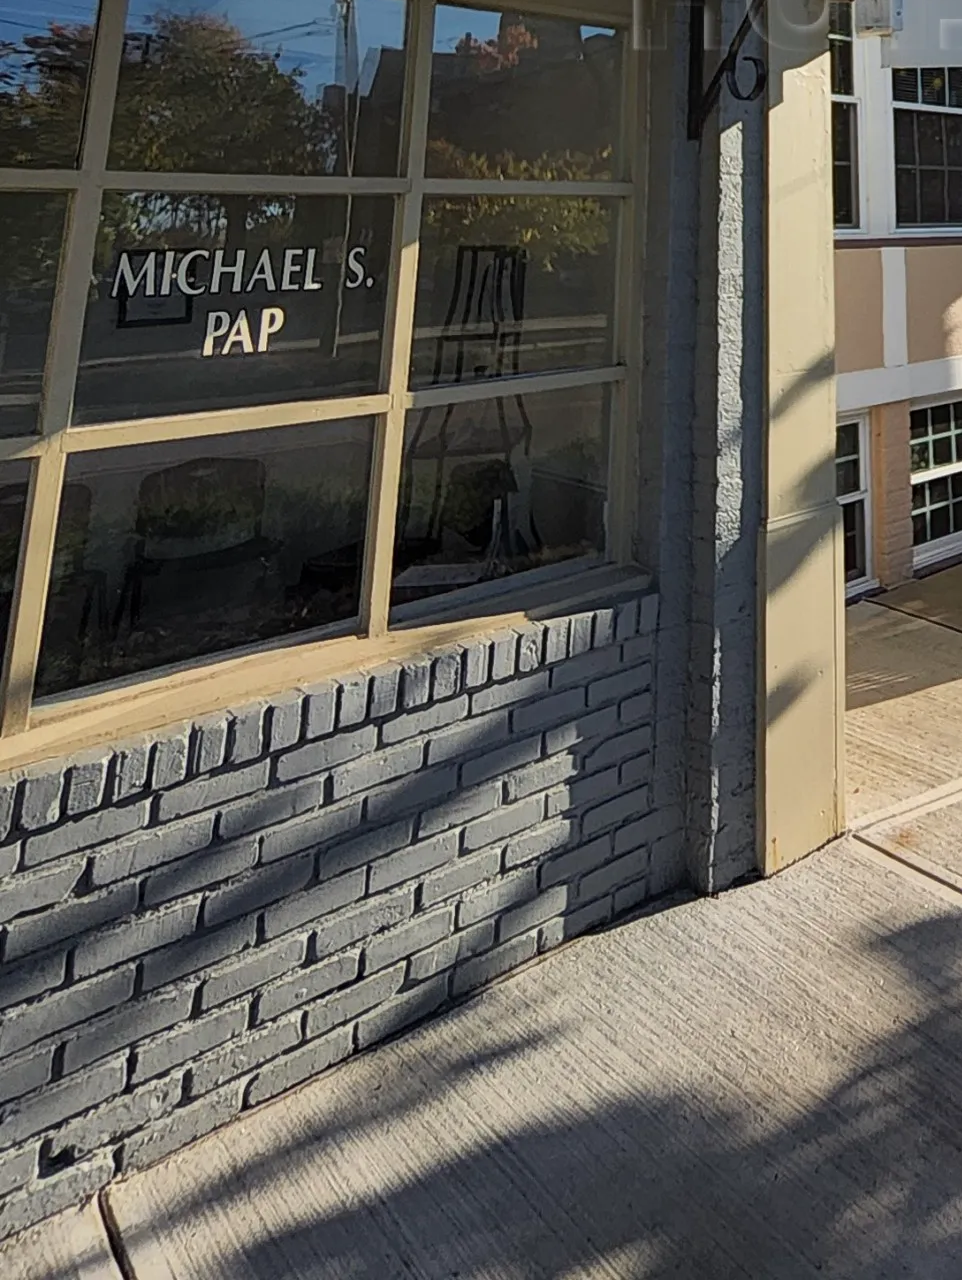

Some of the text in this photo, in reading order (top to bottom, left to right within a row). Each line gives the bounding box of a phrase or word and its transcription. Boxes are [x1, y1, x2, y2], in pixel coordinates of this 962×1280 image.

[111, 246, 374, 298] MICHAEL S.
[201, 306, 285, 358] PAP
